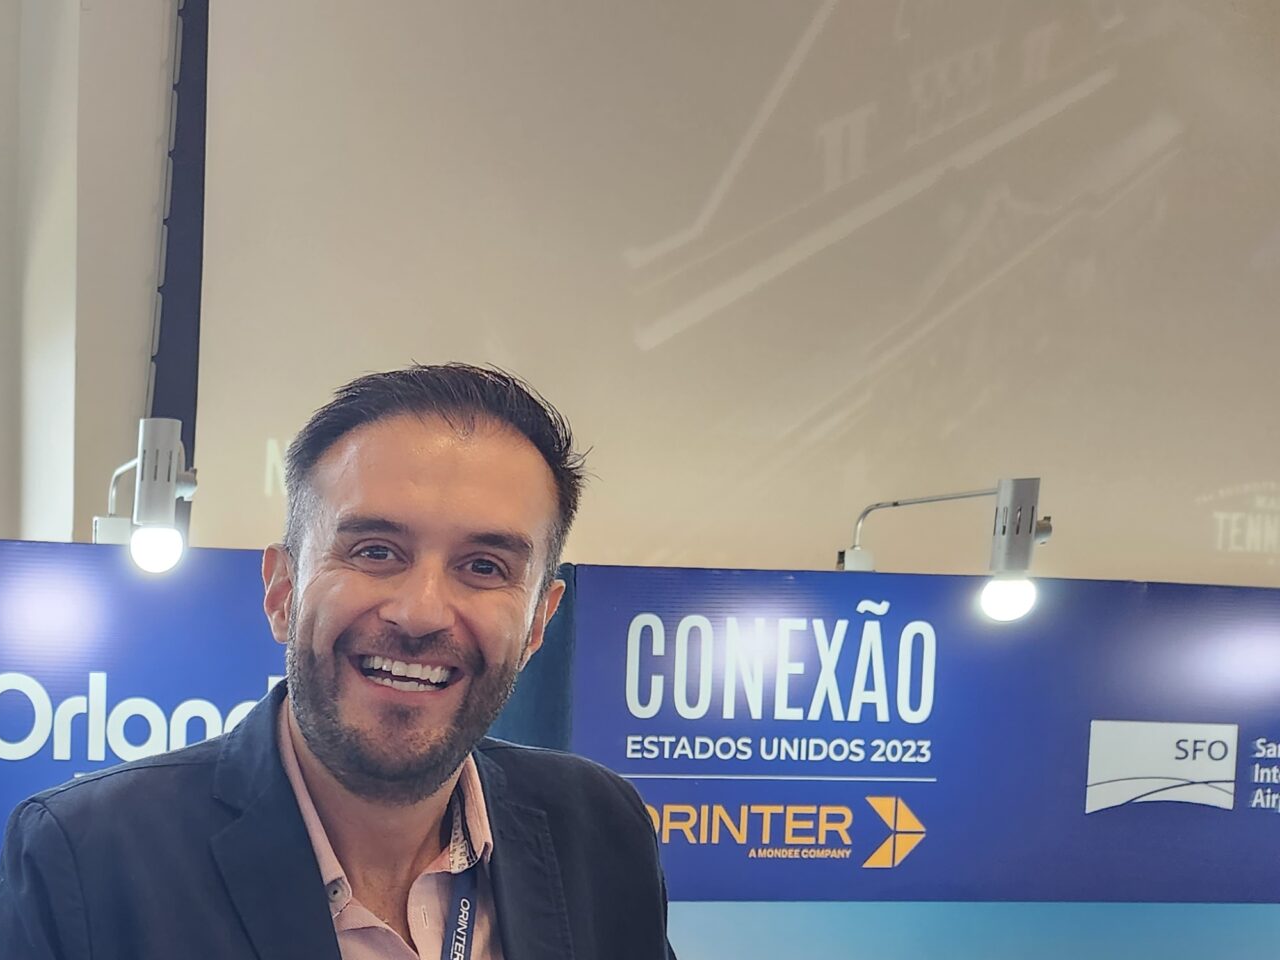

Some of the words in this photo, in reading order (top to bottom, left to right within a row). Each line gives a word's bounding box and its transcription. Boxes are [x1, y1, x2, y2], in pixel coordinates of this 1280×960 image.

[626, 599, 936, 724] CONEXÃO
[626, 735, 752, 760] ESTADOS
[760, 737, 865, 762] UNIDOS
[870, 739, 931, 763] 2023
[1175, 739, 1228, 761] SFO
[1254, 737, 1280, 758] Sa
[1253, 763, 1280, 783] Int
[645, 804, 853, 845] RINTER
[758, 848, 801, 859] MONDEE
[801, 848, 852, 860] COMPANY
